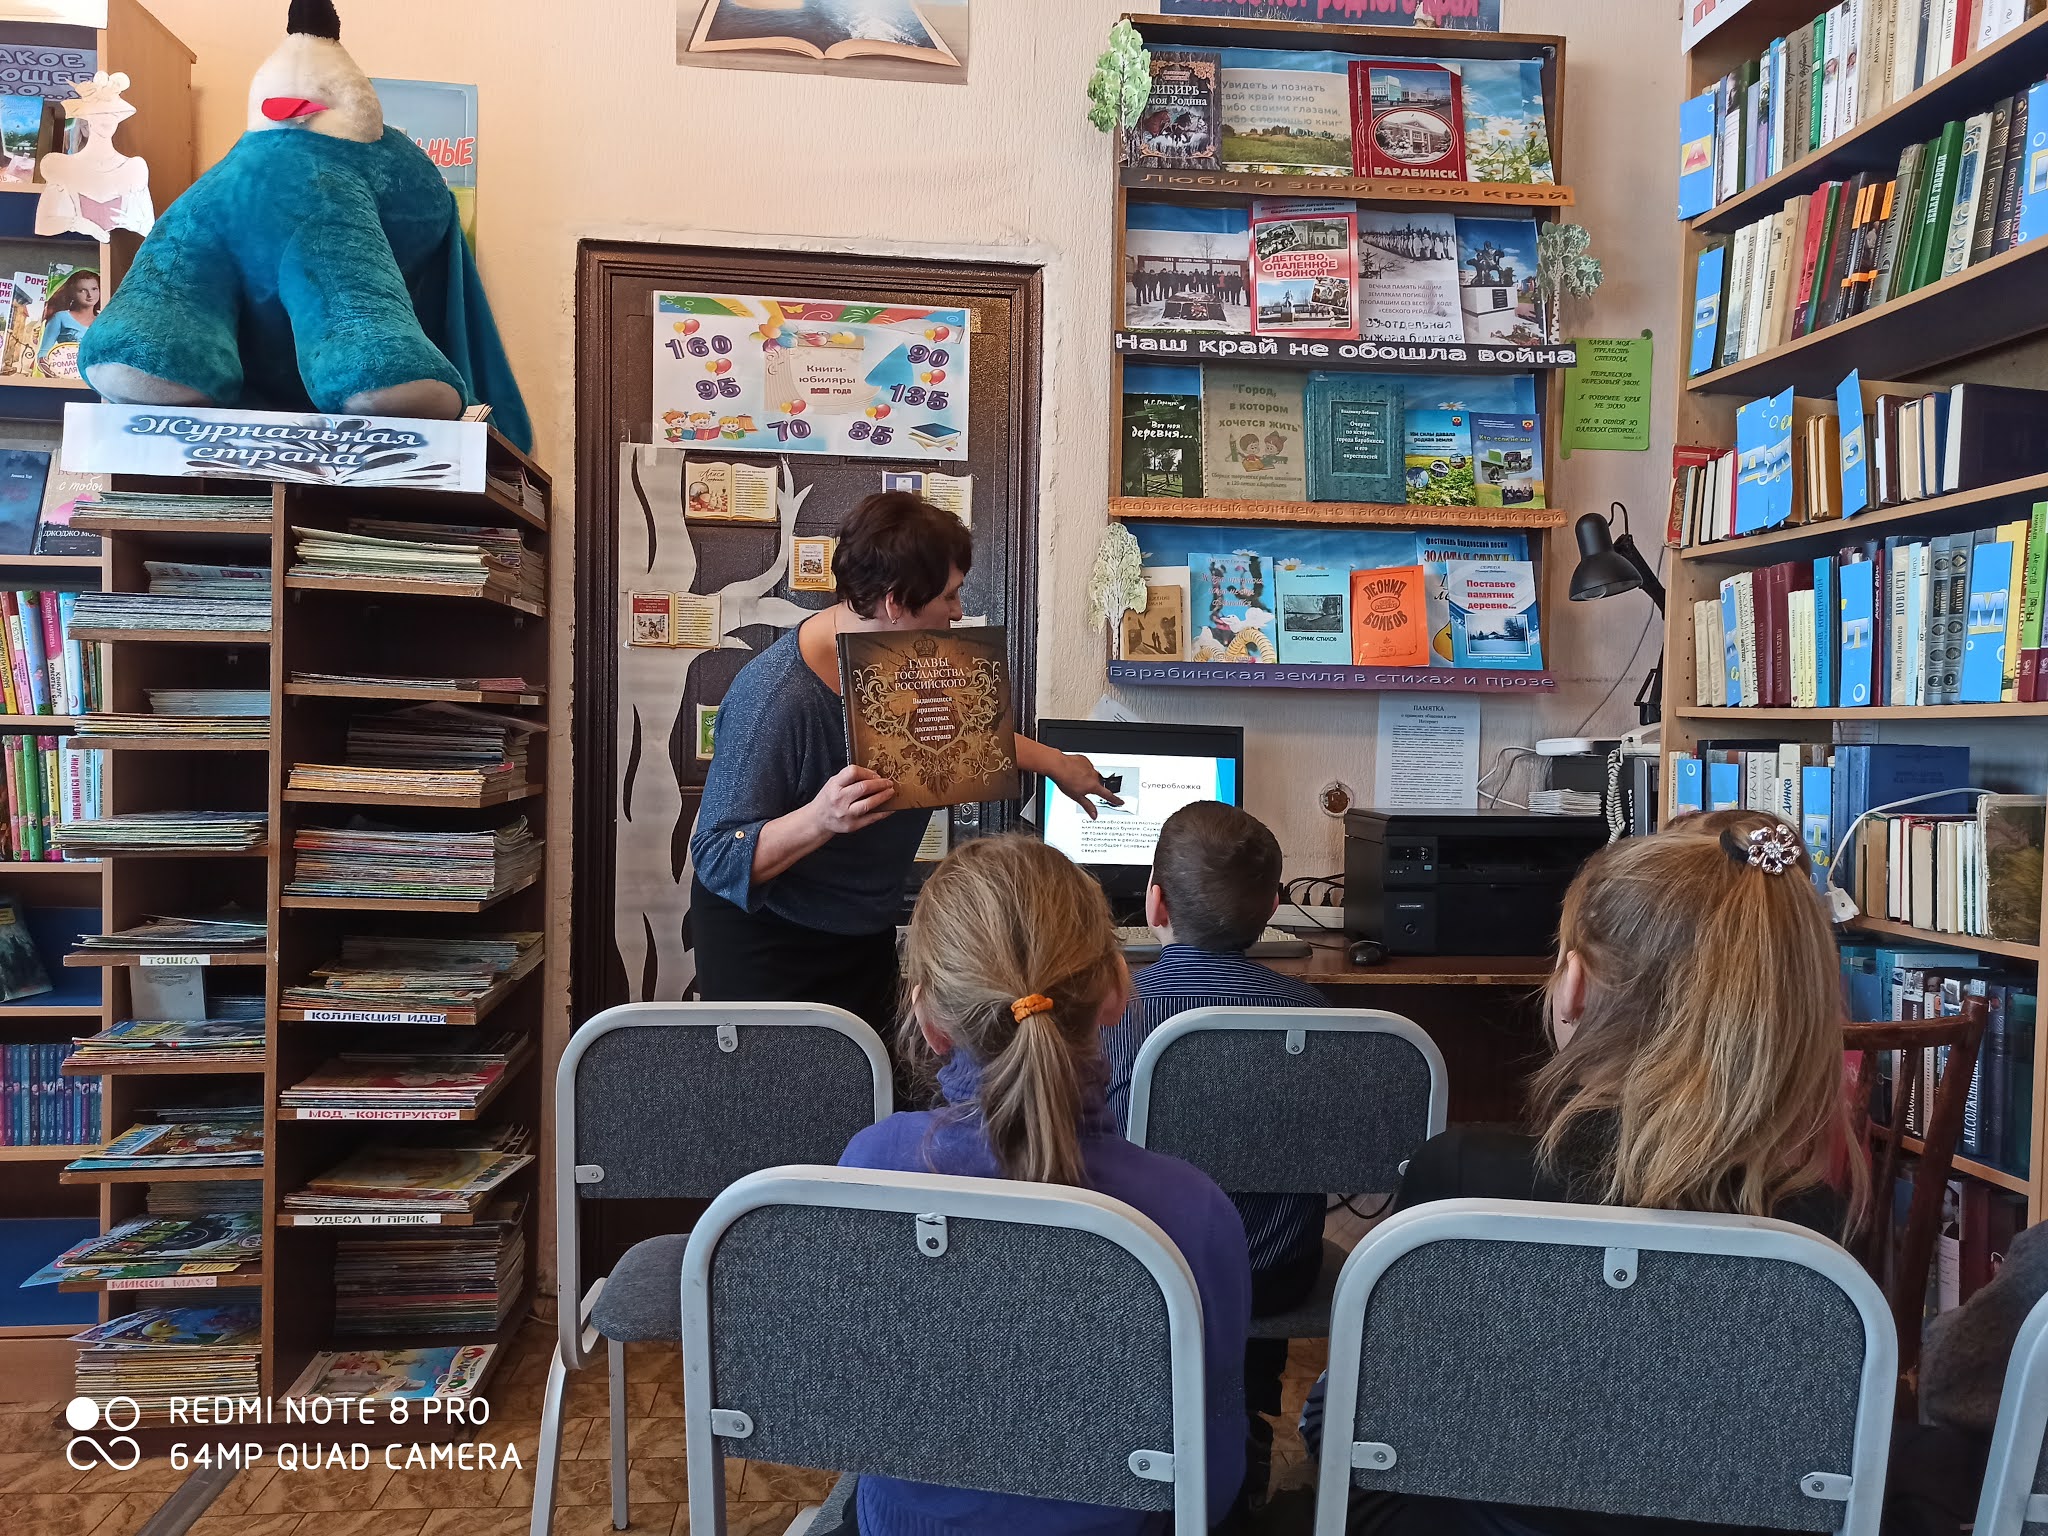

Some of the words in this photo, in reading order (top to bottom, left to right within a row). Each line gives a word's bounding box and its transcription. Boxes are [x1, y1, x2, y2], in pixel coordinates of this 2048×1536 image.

[1282, 83, 1325, 92] познать
[1169, 96, 1207, 107] Родина
[1248, 92, 1274, 103] край
[1374, 166, 1457, 180] БАРАБИНСК
[1140, 174, 1239, 187] Люби
[1254, 179, 1273, 188] и
[1287, 178, 1372, 193] знай
[1384, 183, 1468, 197] свой
[1484, 187, 1568, 201] край
[2003, 166, 2017, 212] БУЛГАКОВ
[1983, 177, 1996, 222] БУЛГАКОВ
[1264, 261, 1336, 271] ОПАЛЕННОЕ
[1275, 269, 1325, 278] ВОЙНОЙ
[665, 334, 732, 360] 160
[1115, 334, 1187, 353] Наш
[1199, 338, 1278, 358] край
[1289, 343, 1330, 357] не
[1339, 342, 1467, 361] обошла
[1478, 346, 1577, 364] война
[907, 344, 950, 368] 90
[806, 364, 846, 375] Книги-
[799, 375, 856, 386] юбиляры
[695, 377, 741, 401] 95
[1232, 383, 1277, 398] "Город,
[890, 383, 949, 410] 135
[1229, 402, 1237, 410] в
[1239, 402, 1289, 414] котором
[1218, 418, 1266, 428] хочется
[132, 417, 421, 446] Журнальная
[768, 419, 812, 442] 70
[848, 420, 894, 446] 85
[192, 446, 362, 466] страна
[1350, 505, 1396, 517] такой
[1401, 508, 1519, 523] удивительный
[1523, 510, 1562, 524] край
[1362, 578, 1408, 600] ЛЕОНИД
[1466, 579, 1516, 588] Поставьте
[1467, 591, 1515, 599] памятник
[1895, 570, 1906, 615] ПОВЕСТИ
[1467, 601, 1517, 610] деревне...
[1362, 611, 1409, 632] БОЙКОВ
[908, 657, 950, 669] ГЛАВЫ
[894, 668, 965, 681] ГОСУДАРСТВА
[1109, 666, 1265, 680] Барабинская
[1274, 670, 1345, 682] земля
[1354, 674, 1366, 682] в
[1375, 674, 1455, 684] стихах
[1464, 676, 1477, 684] и
[1486, 678, 1555, 688] прозе
[894, 678, 966, 691] РОССИЙСКОГО
[912, 695, 953, 705] Выдающиеся
[924, 715, 950, 724] которых
[914, 726, 938, 734] должна
[938, 724, 955, 732] знать
[933, 733, 952, 742] страна
[1141, 781, 1201, 790] Суперобложка
[311, 1012, 401, 1023] КОЛЛЕКЦИЯ
[313, 1215, 363, 1225] УДЕСА
[371, 1215, 381, 1224] И
